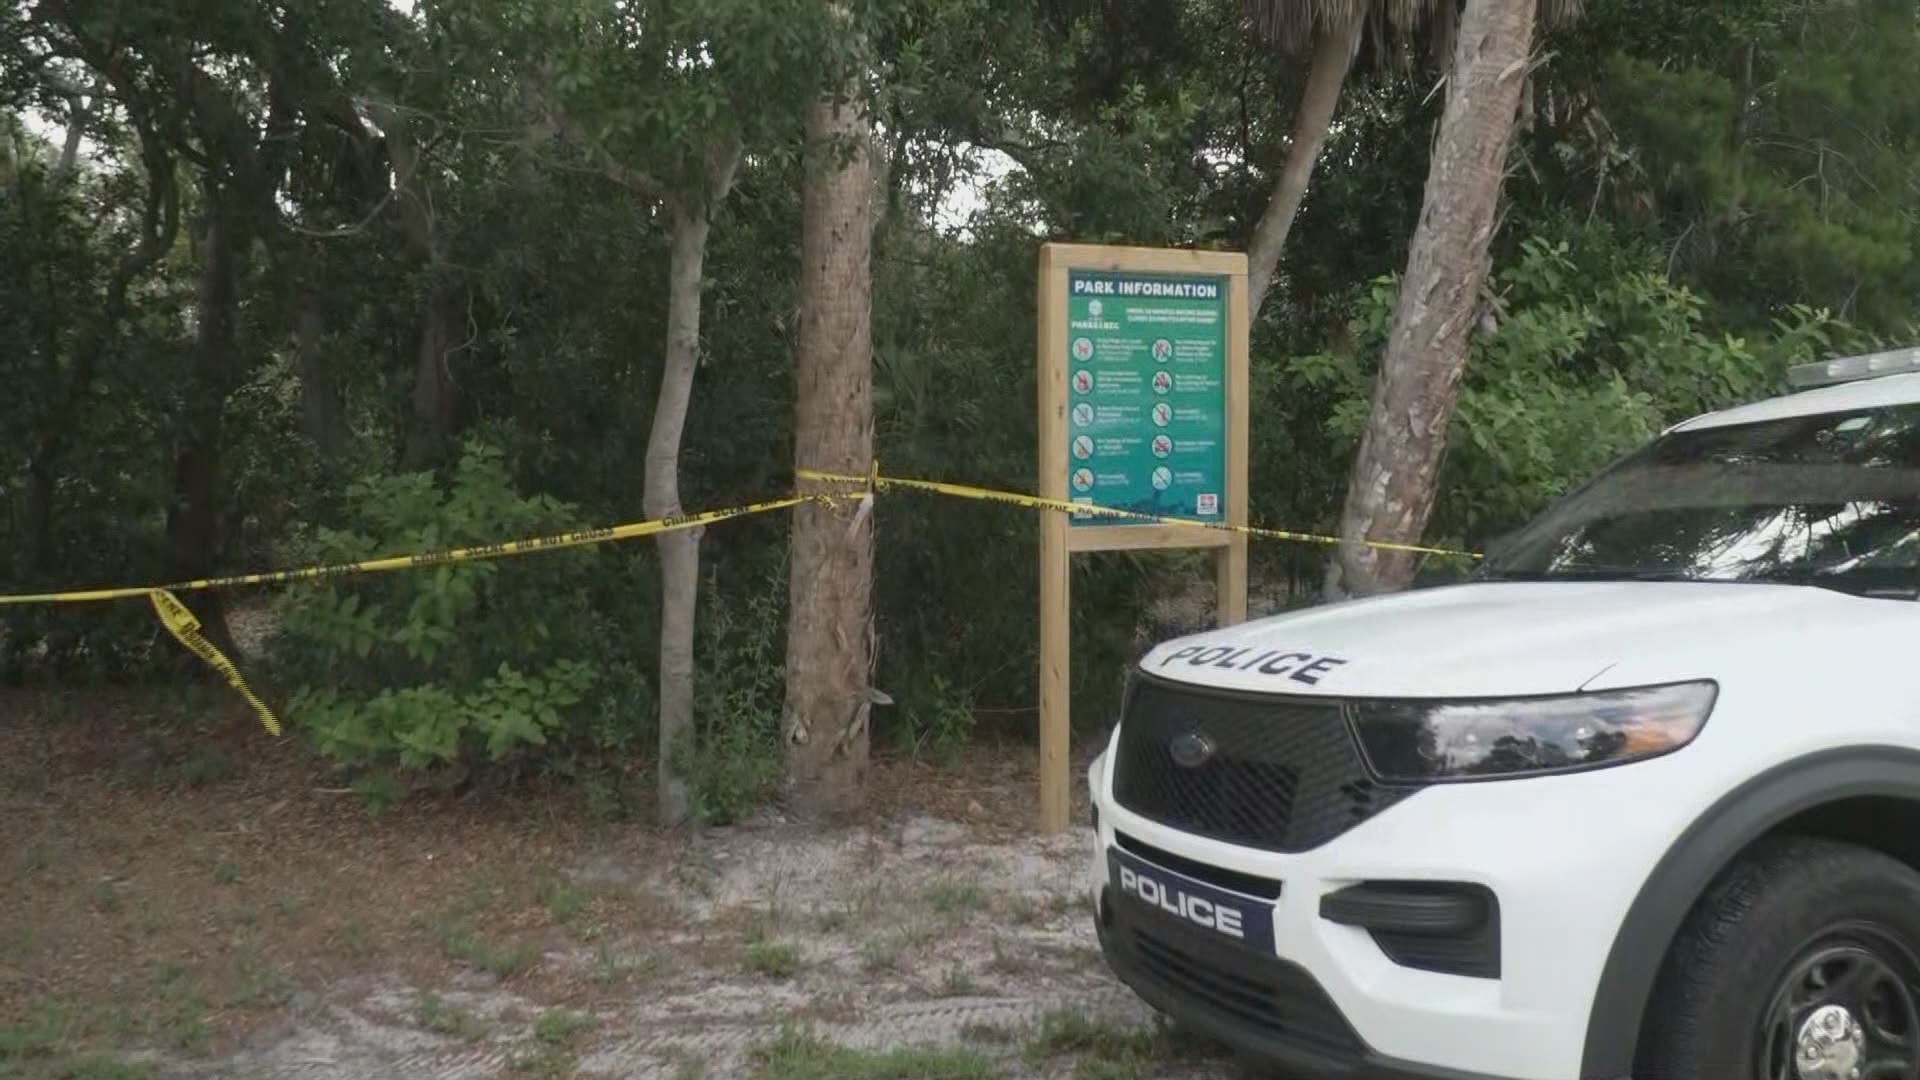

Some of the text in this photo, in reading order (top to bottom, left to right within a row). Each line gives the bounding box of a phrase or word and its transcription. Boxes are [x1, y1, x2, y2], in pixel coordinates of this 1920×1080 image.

[1074, 280, 1217, 298] PARK INFORMATION
[1160, 645, 1348, 685] POLICE
[1119, 865, 1245, 939] POLICE
